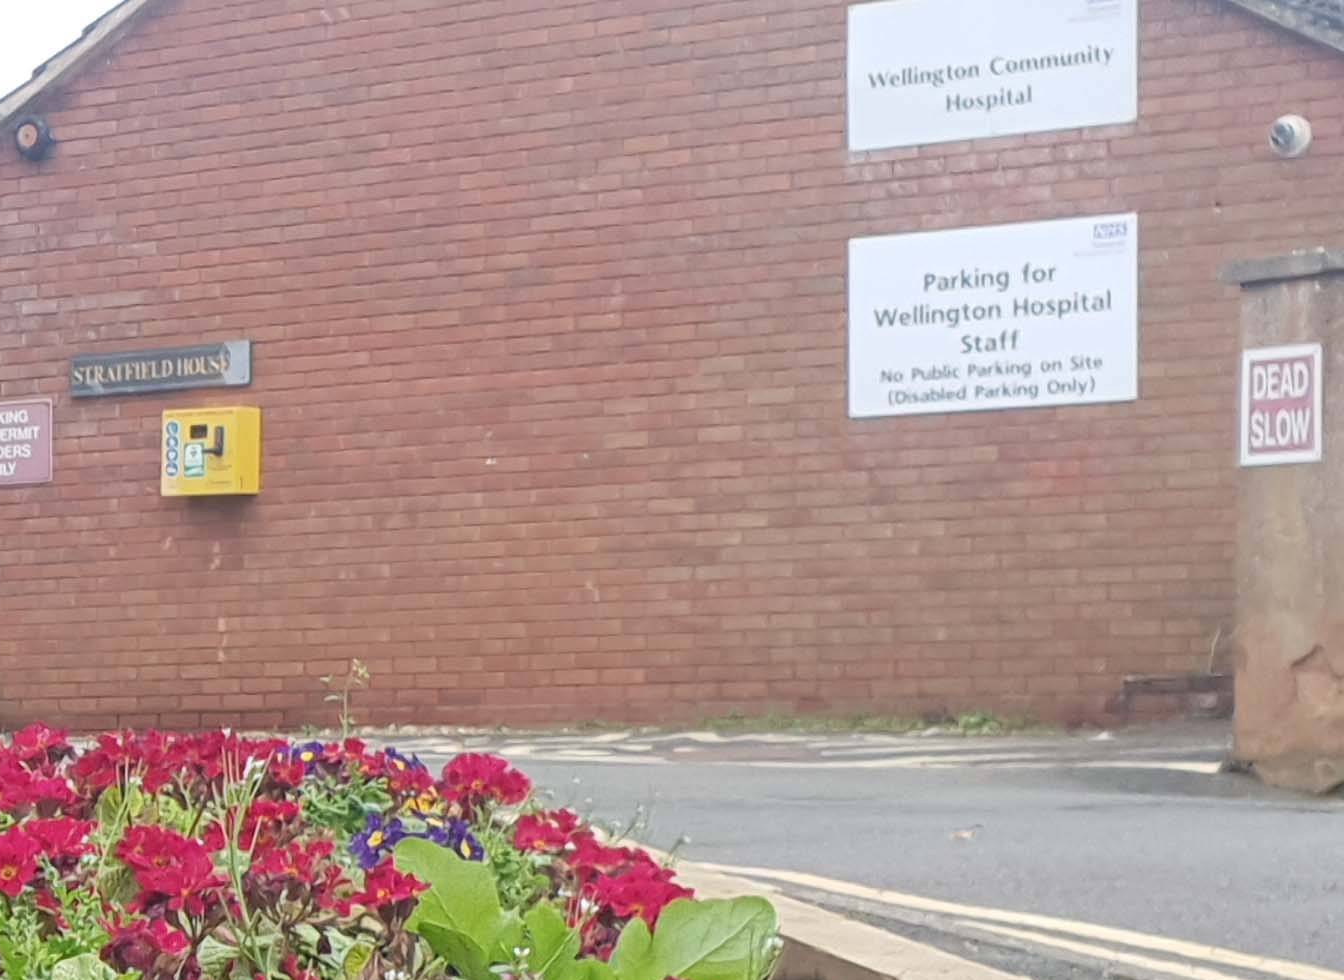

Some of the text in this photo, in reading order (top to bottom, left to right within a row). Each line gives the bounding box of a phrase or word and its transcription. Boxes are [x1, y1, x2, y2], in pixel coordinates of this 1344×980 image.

[868, 44, 1114, 88] Wellington Community
[945, 84, 1033, 112] Hospital
[923, 262, 1056, 292] Parking for
[874, 289, 1112, 328] Wellington Hospital
[960, 330, 1019, 354] Staff
[73, 353, 229, 385] STRATFIELD HOUSE
[880, 354, 1103, 384] No Public Parking on Site
[1253, 361, 1310, 400] DEAD
[887, 375, 1096, 406] (Disabled Parking Only)
[1251, 407, 1311, 447] SLOW
